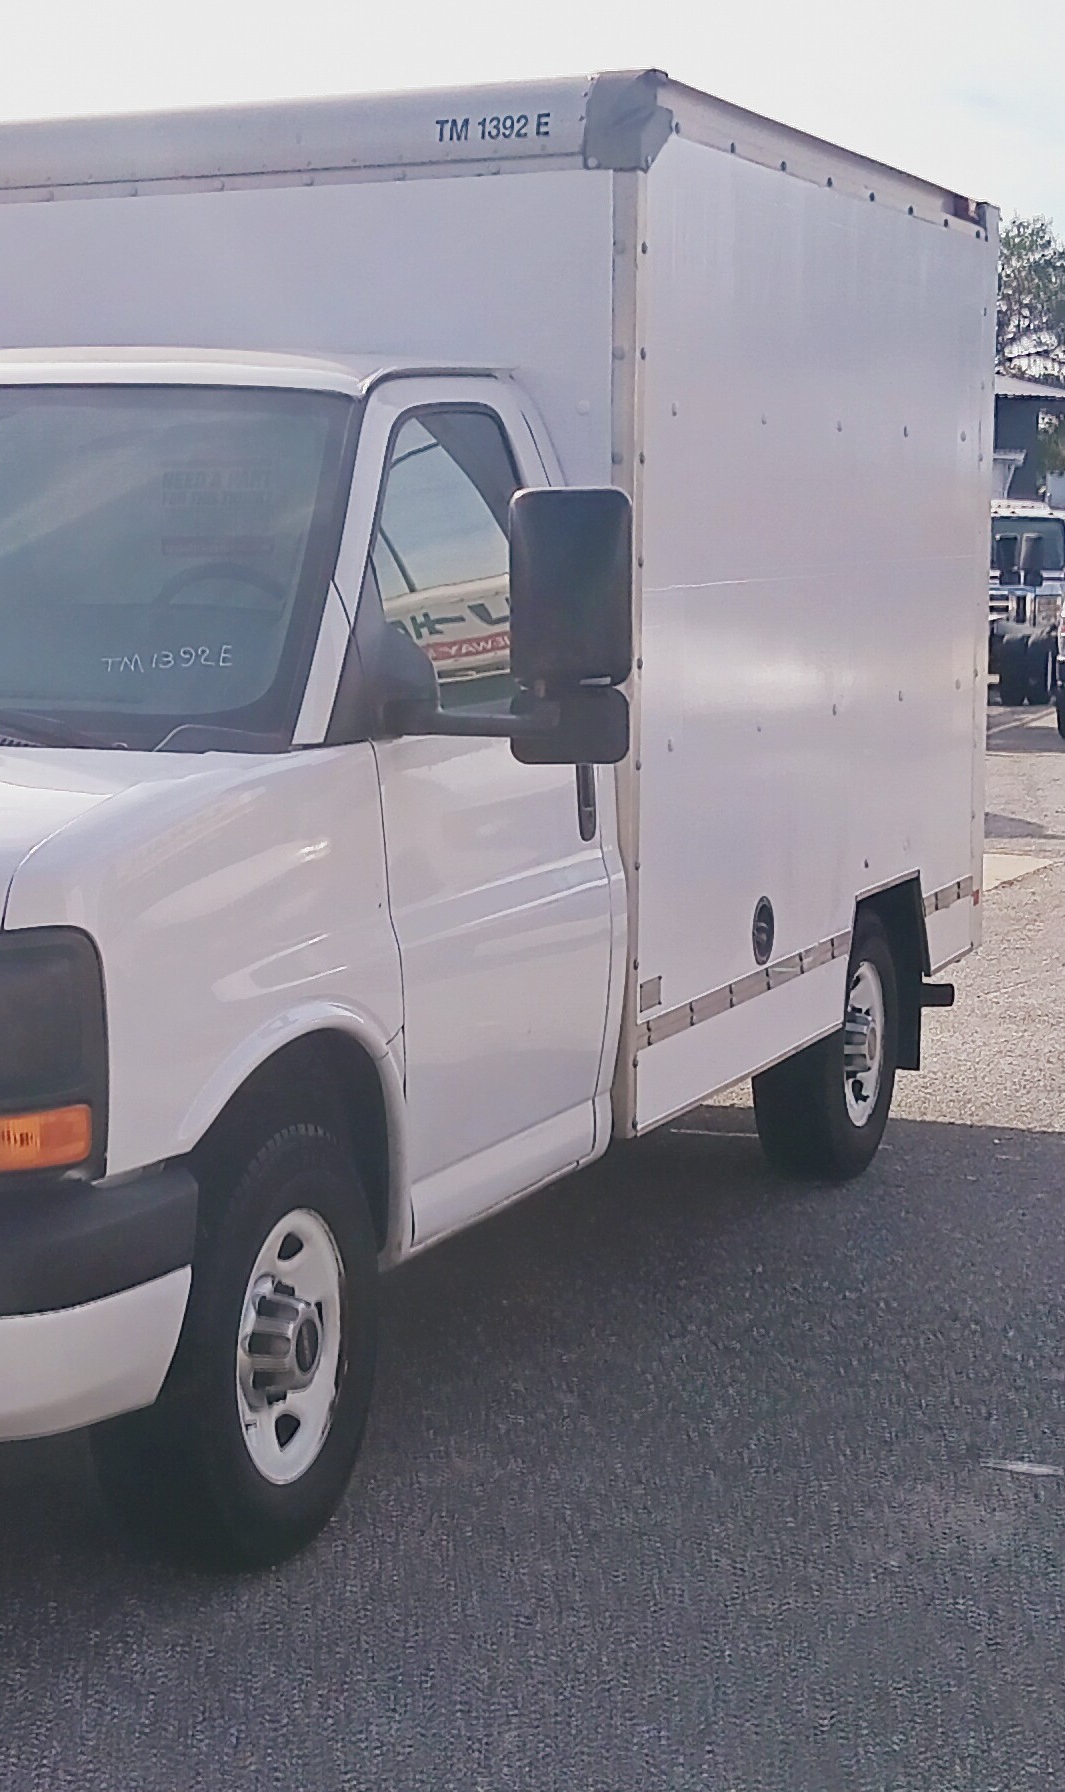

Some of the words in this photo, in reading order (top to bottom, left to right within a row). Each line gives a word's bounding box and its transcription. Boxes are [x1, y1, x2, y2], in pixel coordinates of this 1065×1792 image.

[435, 117, 470, 142] TM
[477, 114, 529, 140] 1392
[535, 112, 551, 137] E
